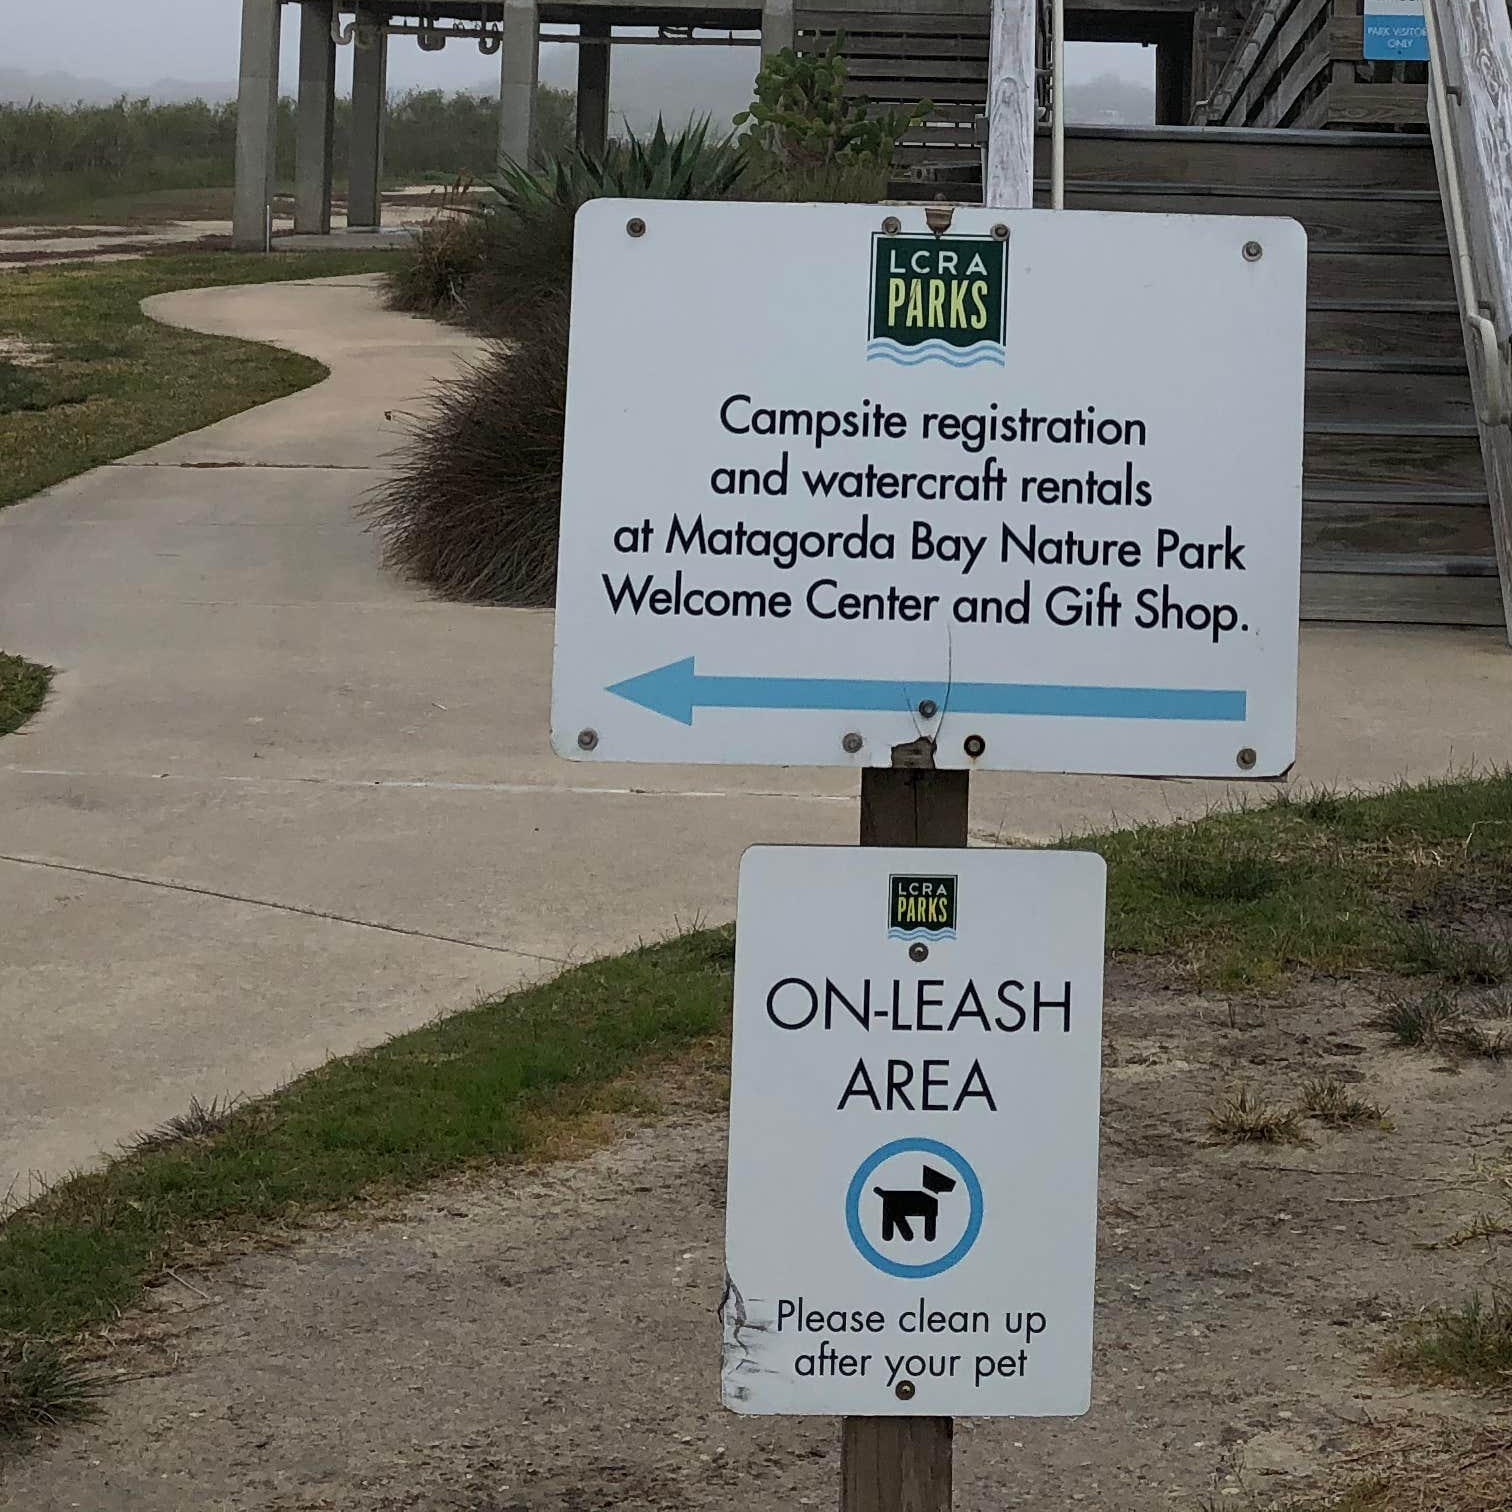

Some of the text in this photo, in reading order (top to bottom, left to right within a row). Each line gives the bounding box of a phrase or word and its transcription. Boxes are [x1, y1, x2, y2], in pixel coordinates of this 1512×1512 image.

[890, 250, 987, 275] LCRA
[889, 278, 987, 329] PARKS
[720, 394, 1145, 453] Campsite registration
[711, 451, 1152, 506] and watercraft rentals
[614, 513, 1245, 574] at Matagorda Bay Nature Park
[602, 570, 1248, 643] Welcome Center and Gift Shop.
[898, 897, 947, 922] PARKS
[899, 883, 947, 895] LCRA
[767, 977, 1071, 1032] ON-LEASH
[837, 1058, 997, 1111] AREA
[778, 1297, 1047, 1344] Please clean up
[795, 1343, 1027, 1387] after your pet
